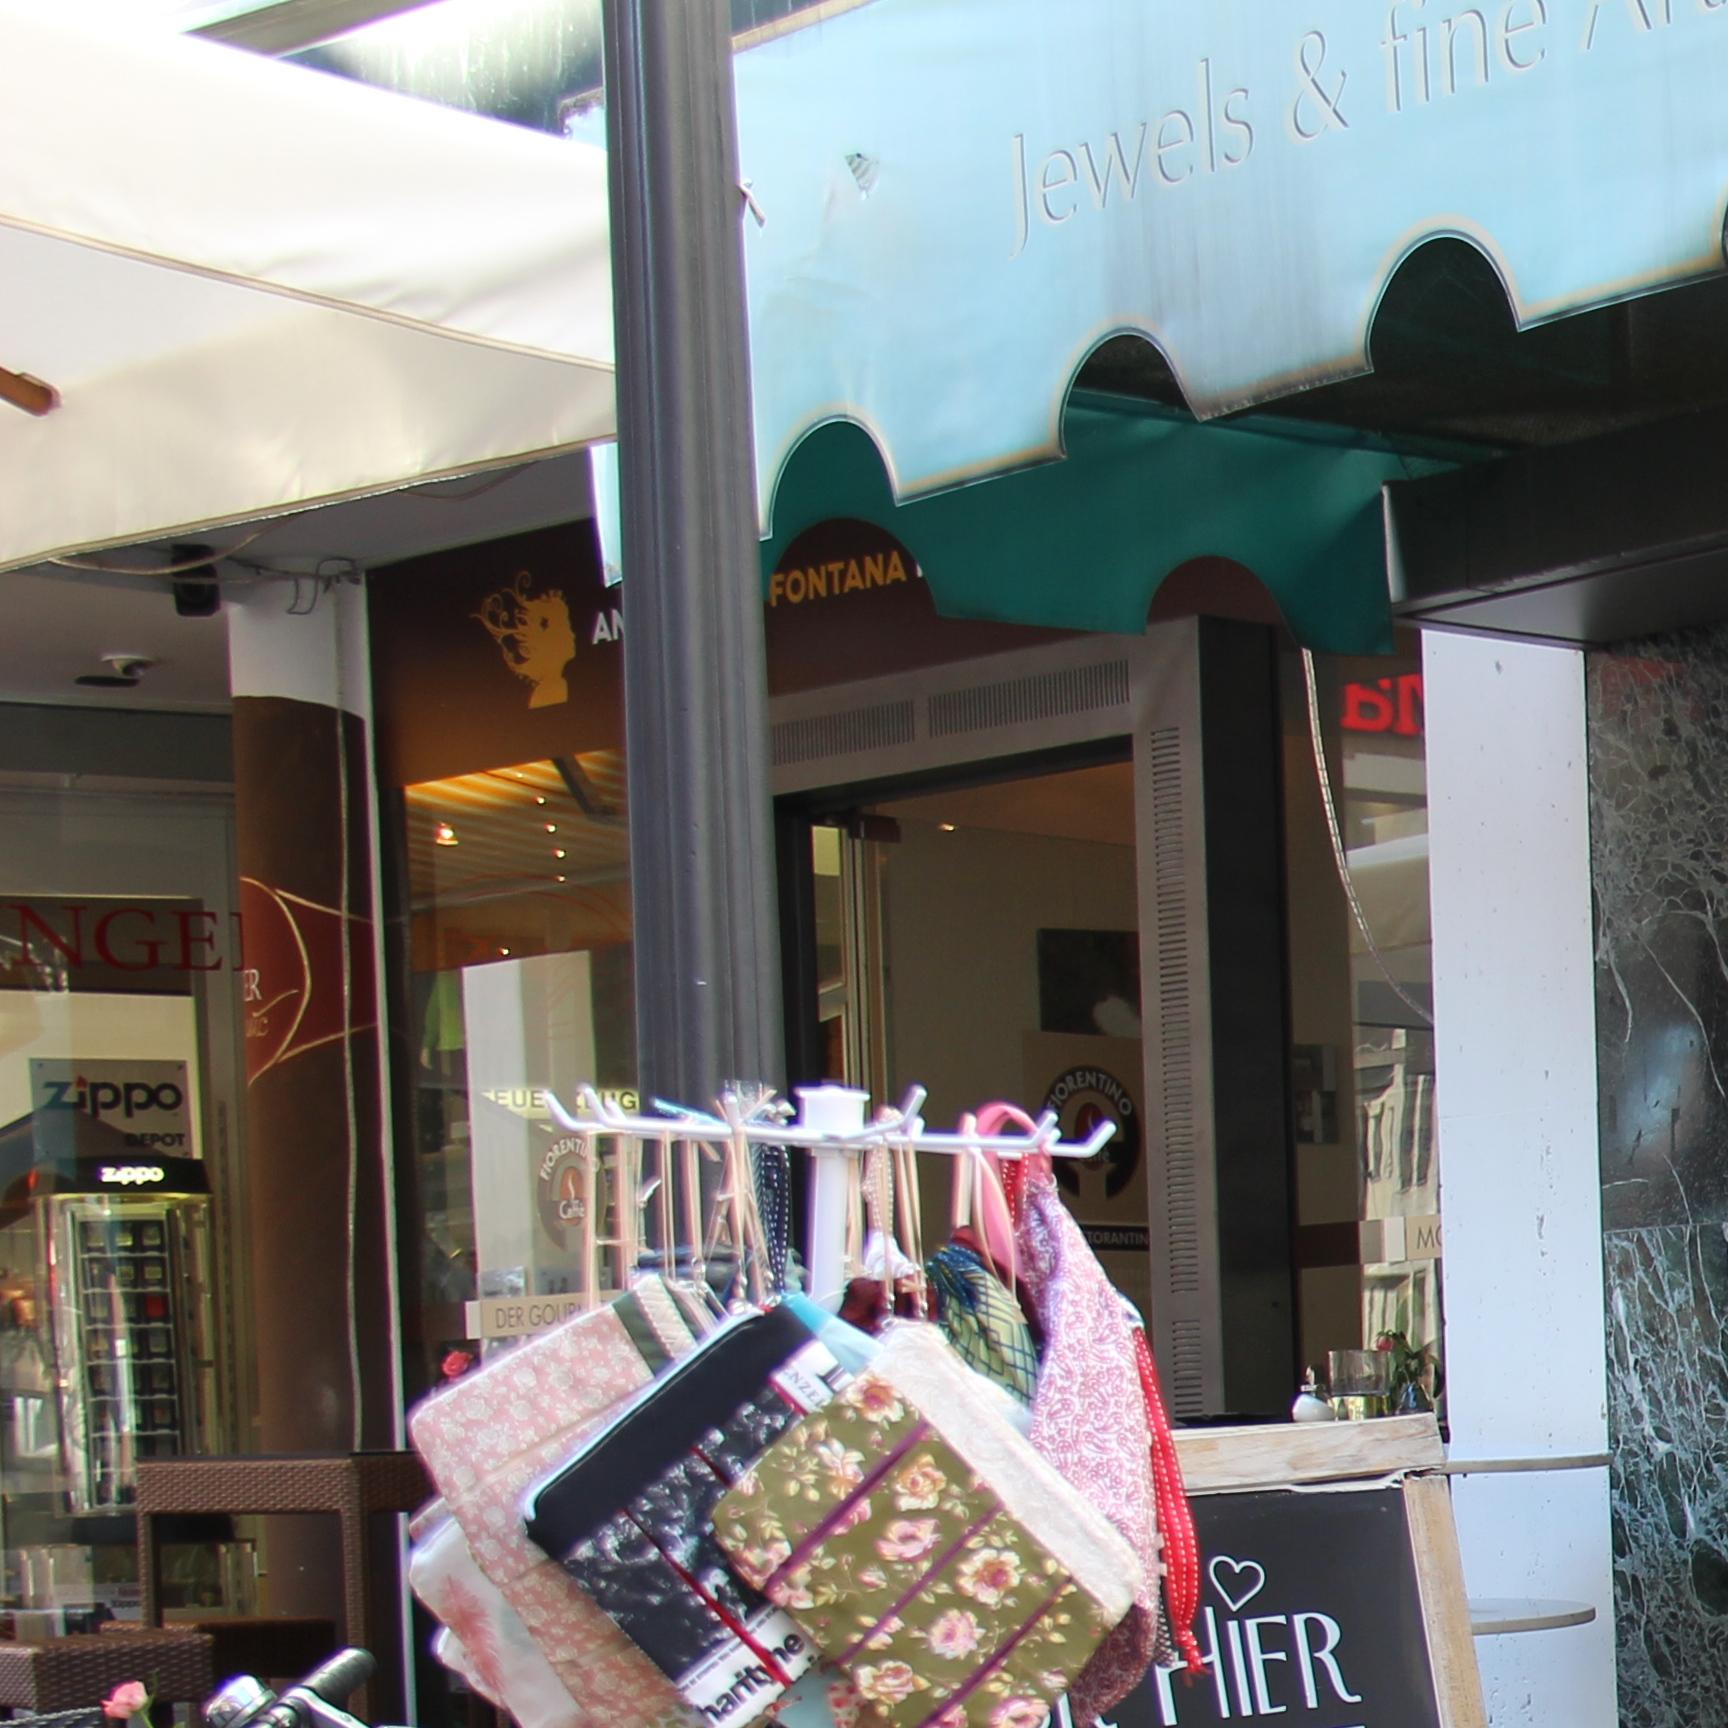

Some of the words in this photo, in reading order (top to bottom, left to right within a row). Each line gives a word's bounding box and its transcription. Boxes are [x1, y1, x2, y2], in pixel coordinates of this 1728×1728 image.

[1009, 57, 1254, 260] Jewels
[1291, 29, 1349, 141] &
[1378, 0, 1547, 112] fine
[769, 551, 907, 608] FONTANA
[125, 1132, 186, 1148] DEPOT
[495, 1305, 525, 1330] DER
[528, 1302, 583, 1327] GOUR
[1154, 1606, 1363, 1728] HIER
